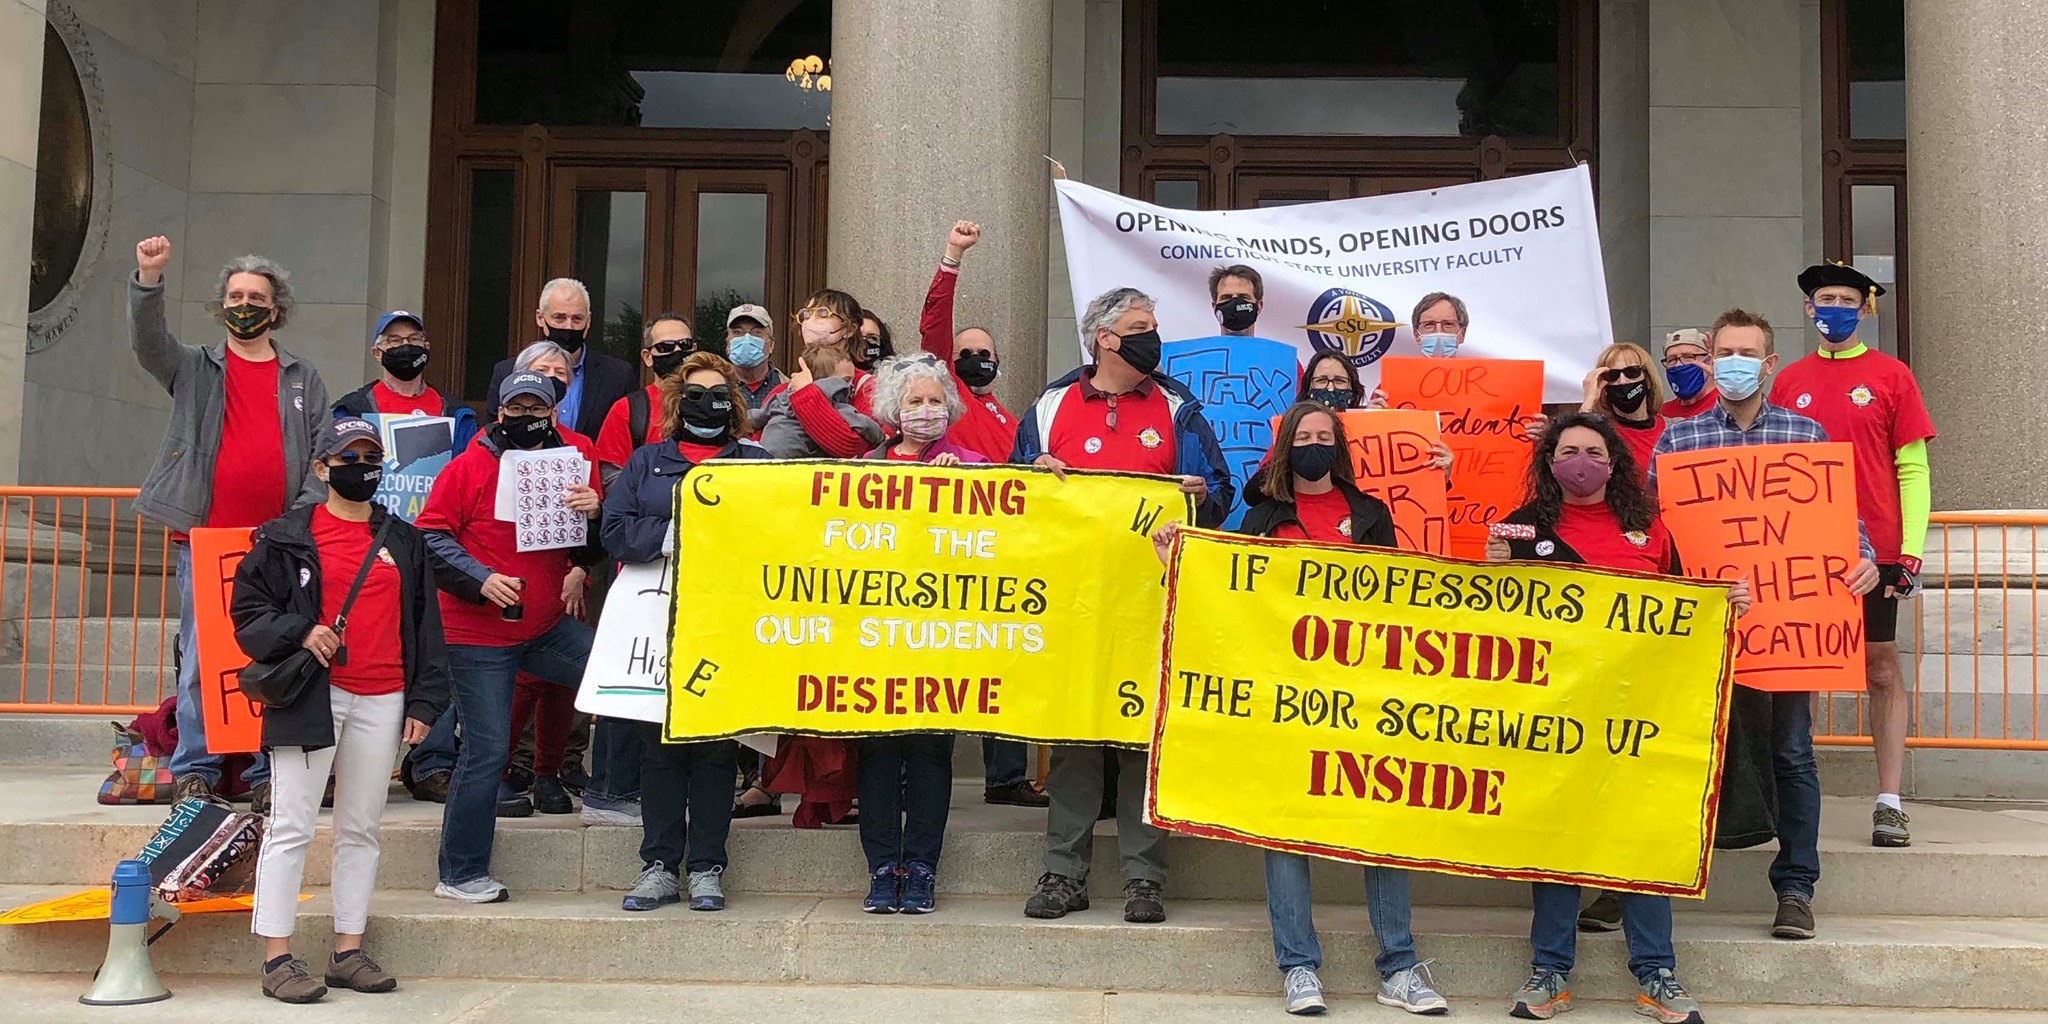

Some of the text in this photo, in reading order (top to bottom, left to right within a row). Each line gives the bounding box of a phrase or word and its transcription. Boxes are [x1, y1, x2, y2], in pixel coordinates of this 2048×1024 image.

[1115, 206, 1565, 258] OPENING MINDS, OPENING DOORS
[1160, 245, 1524, 278] CONNECTICUT STATE UNIVERSITY FACULTY
[1335, 319, 1368, 333] CSU
[1167, 348, 1292, 415] TAX
[1419, 366, 1499, 399] OUR
[334, 420, 373, 431] WCSU
[526, 418, 548, 431] aaup
[1452, 447, 1514, 475] THE
[1672, 452, 1844, 507] INVEST
[377, 473, 437, 493] ECOVER
[693, 473, 721, 507] C
[810, 470, 1028, 517] FIGHTING
[372, 494, 401, 516] OR
[1129, 497, 1165, 538] W
[822, 518, 998, 559] FOR THE
[1721, 510, 1791, 549] IN
[761, 564, 1048, 616] UNIVERSITIES
[1229, 552, 1699, 637] IF PROFESSORS ARE
[754, 614, 1045, 654] OUR STUDENTS
[1291, 613, 1553, 687] OUTSIDE
[1735, 617, 1862, 659] CATION
[796, 673, 1003, 716] DESERVE
[1178, 670, 1660, 758] THE BOR SCREWED UP
[1306, 749, 1507, 817] INSIDE
